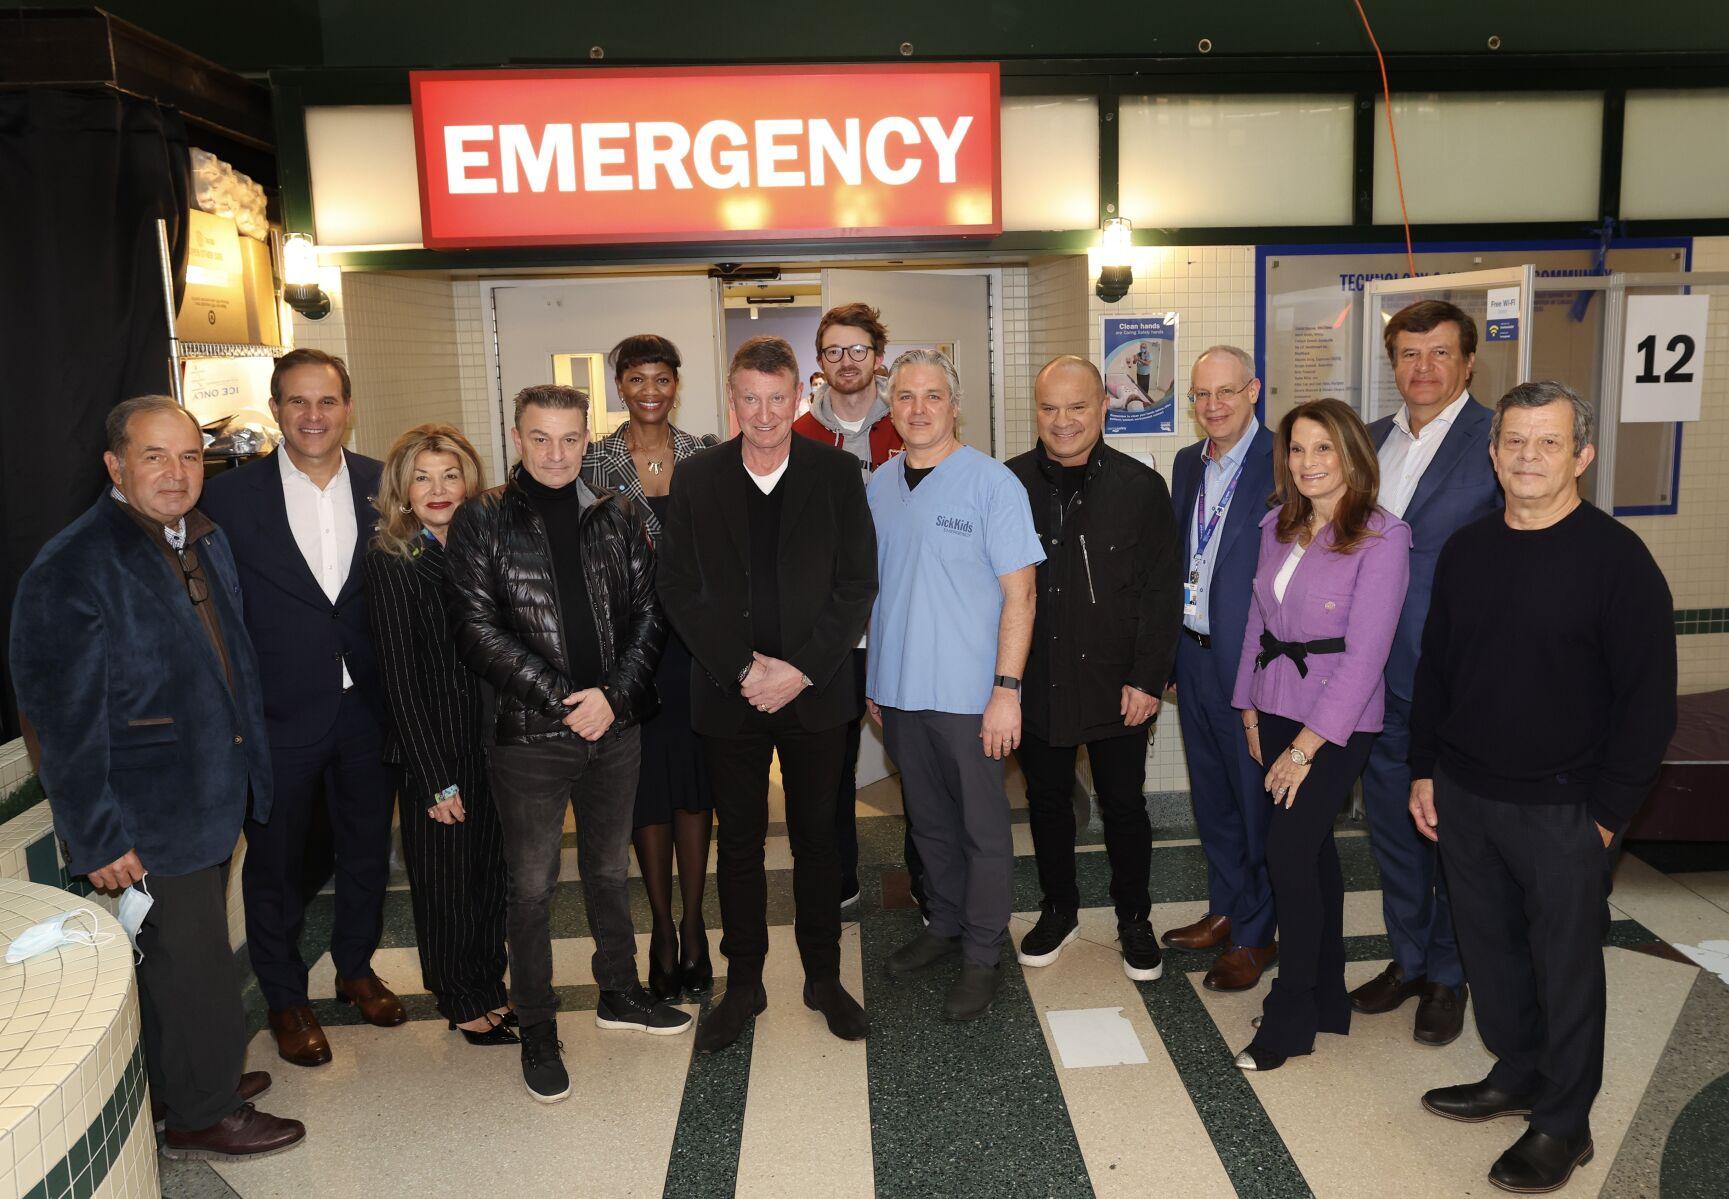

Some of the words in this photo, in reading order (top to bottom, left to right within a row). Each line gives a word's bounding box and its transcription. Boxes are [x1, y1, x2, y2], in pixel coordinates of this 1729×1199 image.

[443, 116, 975, 194] EMERGENCY
[1490, 300, 1502, 308] Free
[1635, 334, 1696, 384] 12
[192, 389, 219, 401] ONLY
[222, 386, 240, 396] ICE
[936, 515, 974, 533] SickKids
